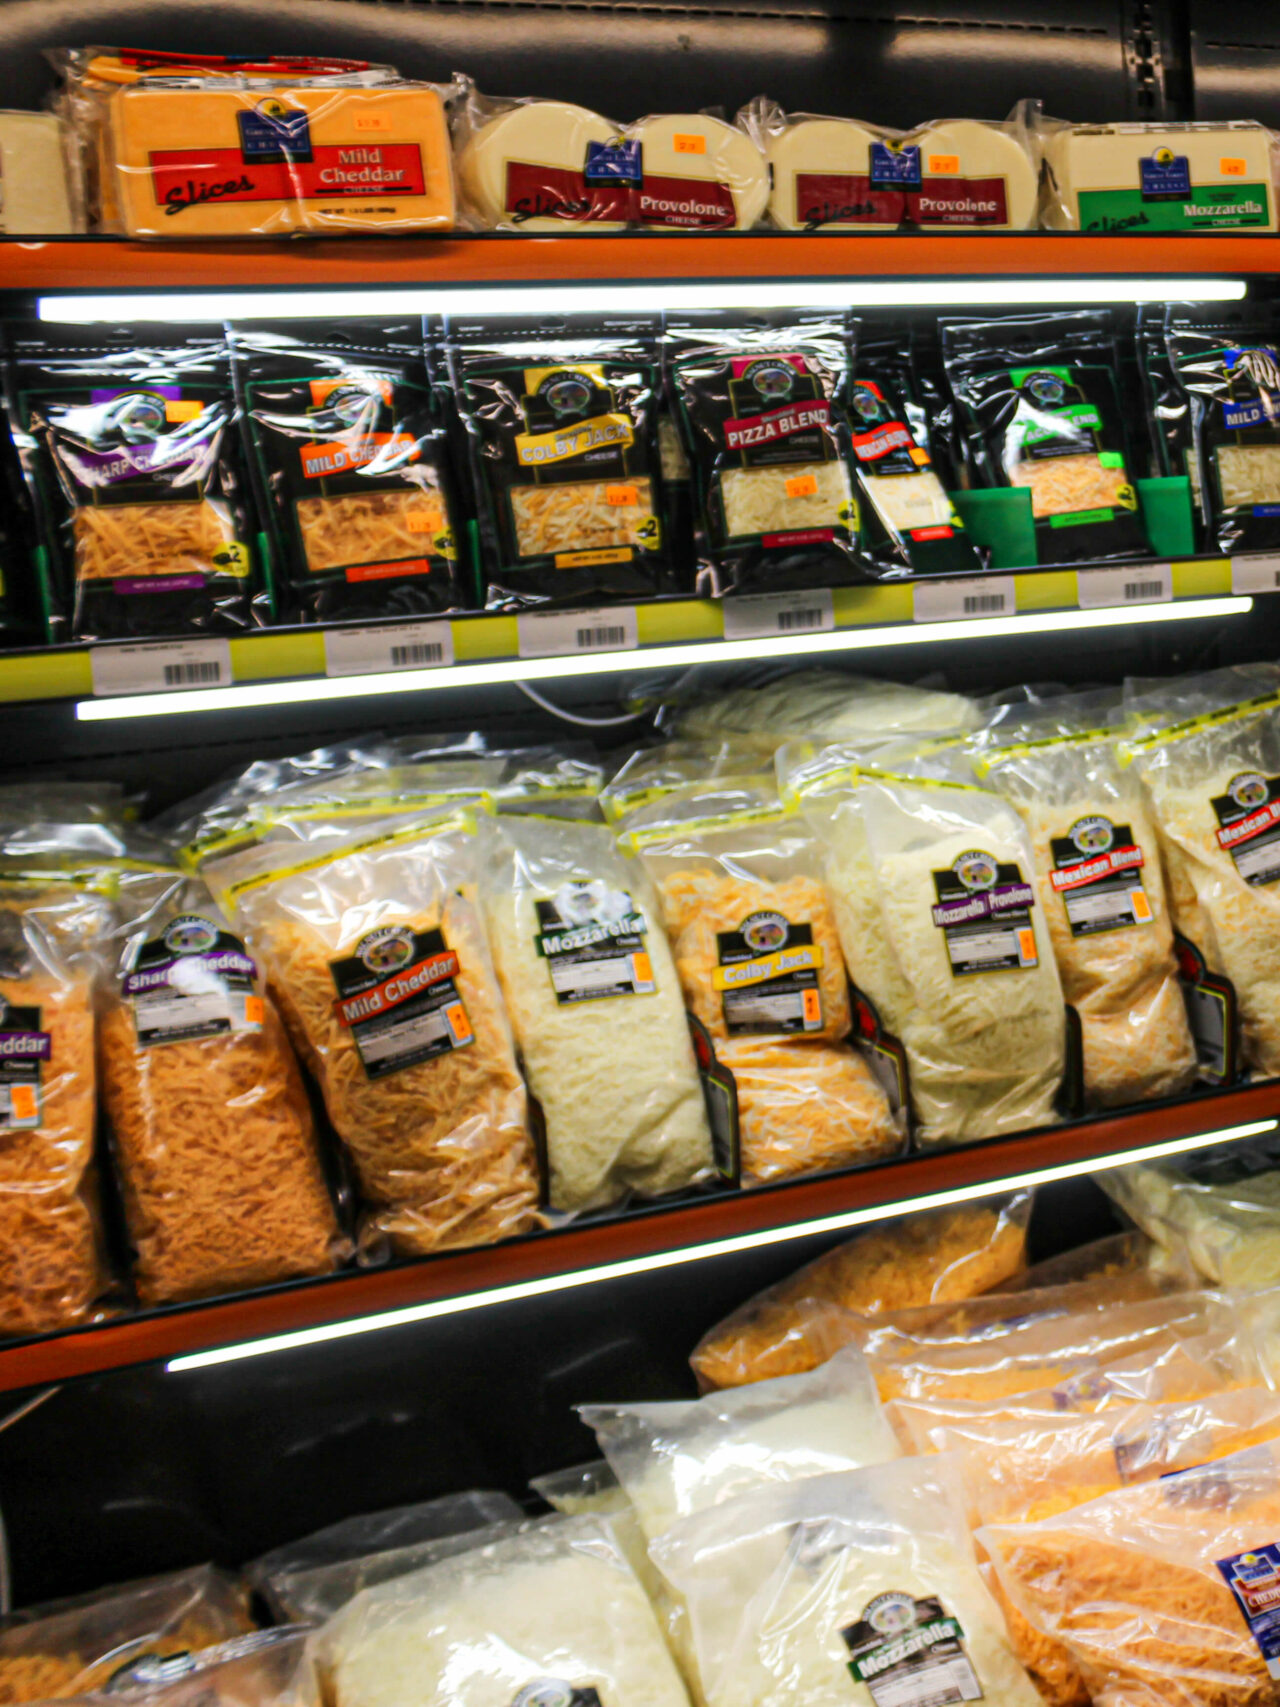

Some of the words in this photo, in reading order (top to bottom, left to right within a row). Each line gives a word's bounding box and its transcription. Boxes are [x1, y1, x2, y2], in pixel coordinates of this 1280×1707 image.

[338, 149, 382, 164] Mild
[320, 168, 404, 183] Cheddar
[165, 176, 255, 216] Slices
[640, 196, 726, 216] Provolone
[919, 198, 998, 212] Provolone
[1184, 201, 1264, 217] Mozzarella
[803, 200, 877, 231] Slices
[728, 425, 776, 447] PIZZA
[779, 409, 829, 433] BLEND
[1226, 409, 1261, 427] MILD
[521, 437, 579, 462] COLBY
[584, 422, 629, 447] JACK
[305, 452, 347, 475] MILD
[1052, 859, 1110, 886] Mexican
[1110, 847, 1142, 868] Blend
[542, 918, 641, 956] Mozzarella
[192, 954, 252, 973] heddar
[723, 961, 772, 984] Colby
[775, 951, 813, 971] Jack
[341, 991, 383, 1022] Mild
[384, 957, 455, 1002] Cheddar
[0, 1034, 48, 1055] ddar
[857, 1621, 957, 1680] Mozzarella
